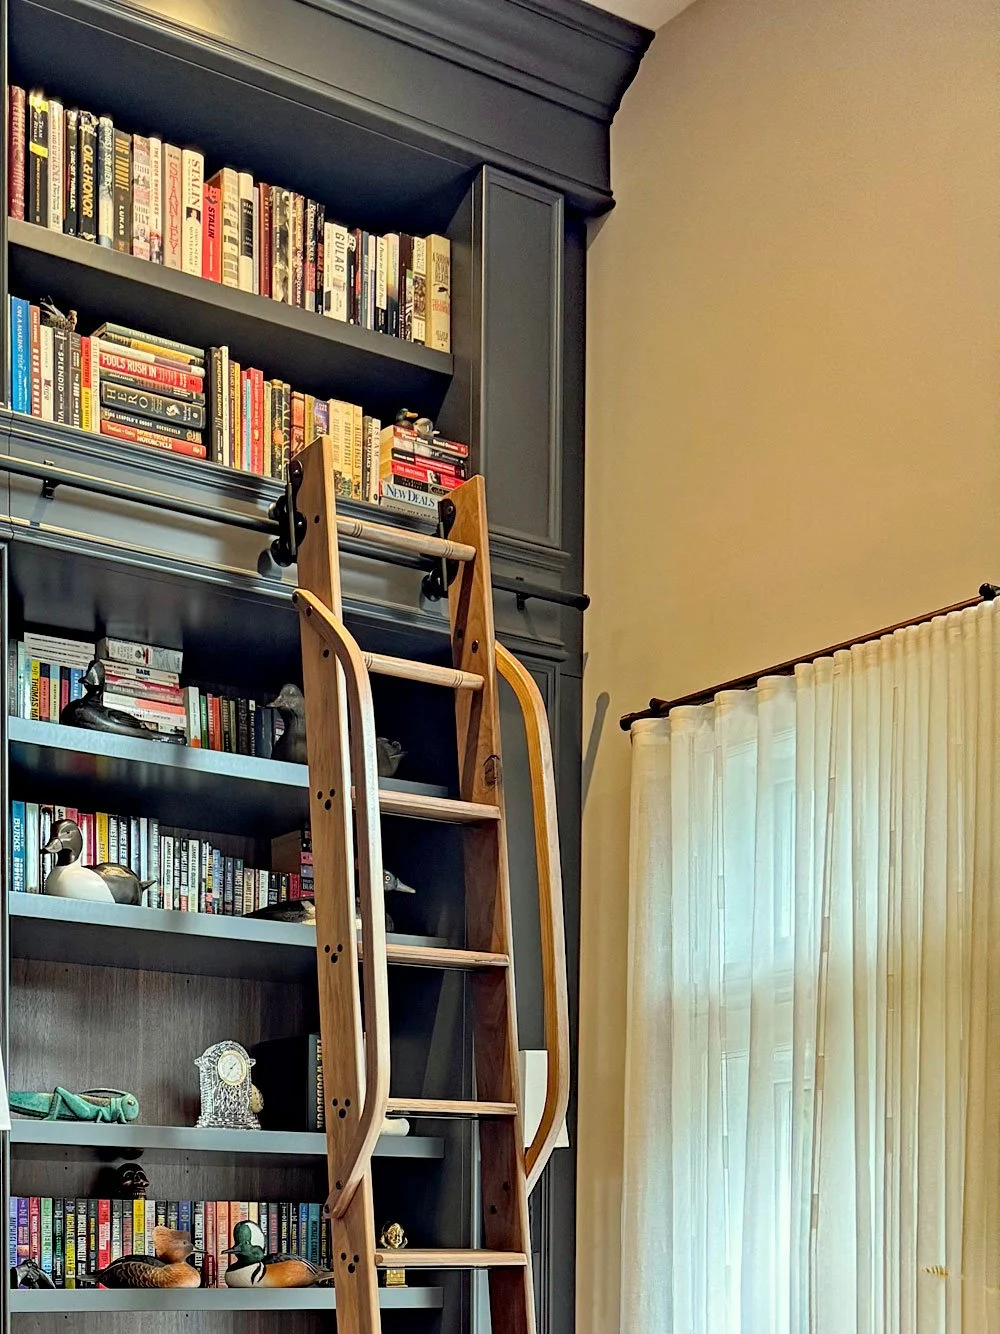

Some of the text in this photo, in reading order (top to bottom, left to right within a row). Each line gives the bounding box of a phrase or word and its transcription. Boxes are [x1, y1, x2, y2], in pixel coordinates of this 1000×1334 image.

[104, 127, 112, 188] GHOST SOLDIERS
[191, 159, 201, 208] STALIN
[168, 162, 179, 255] STANLEY
[208, 206, 216, 239] STALIN
[335, 232, 345, 273] GULAG
[32, 348, 40, 373] BUSH
[102, 353, 157, 378] FOOLS RUSH IN
[107, 388, 149, 409] HERO
[386, 484, 435, 508] NEW DEALS
[31, 678, 39, 707] THOMAS
[119, 821, 128, 859] JAMES LEE
[42, 1215, 52, 1244] MICHAEL
[66, 1213, 75, 1268] MICHAEL CONNELLY
[77, 1214, 87, 1261] MICHAEL CONNELLY
[195, 1213, 203, 1239] MICHAEL
[311, 1220, 319, 1241] MICHAEL
